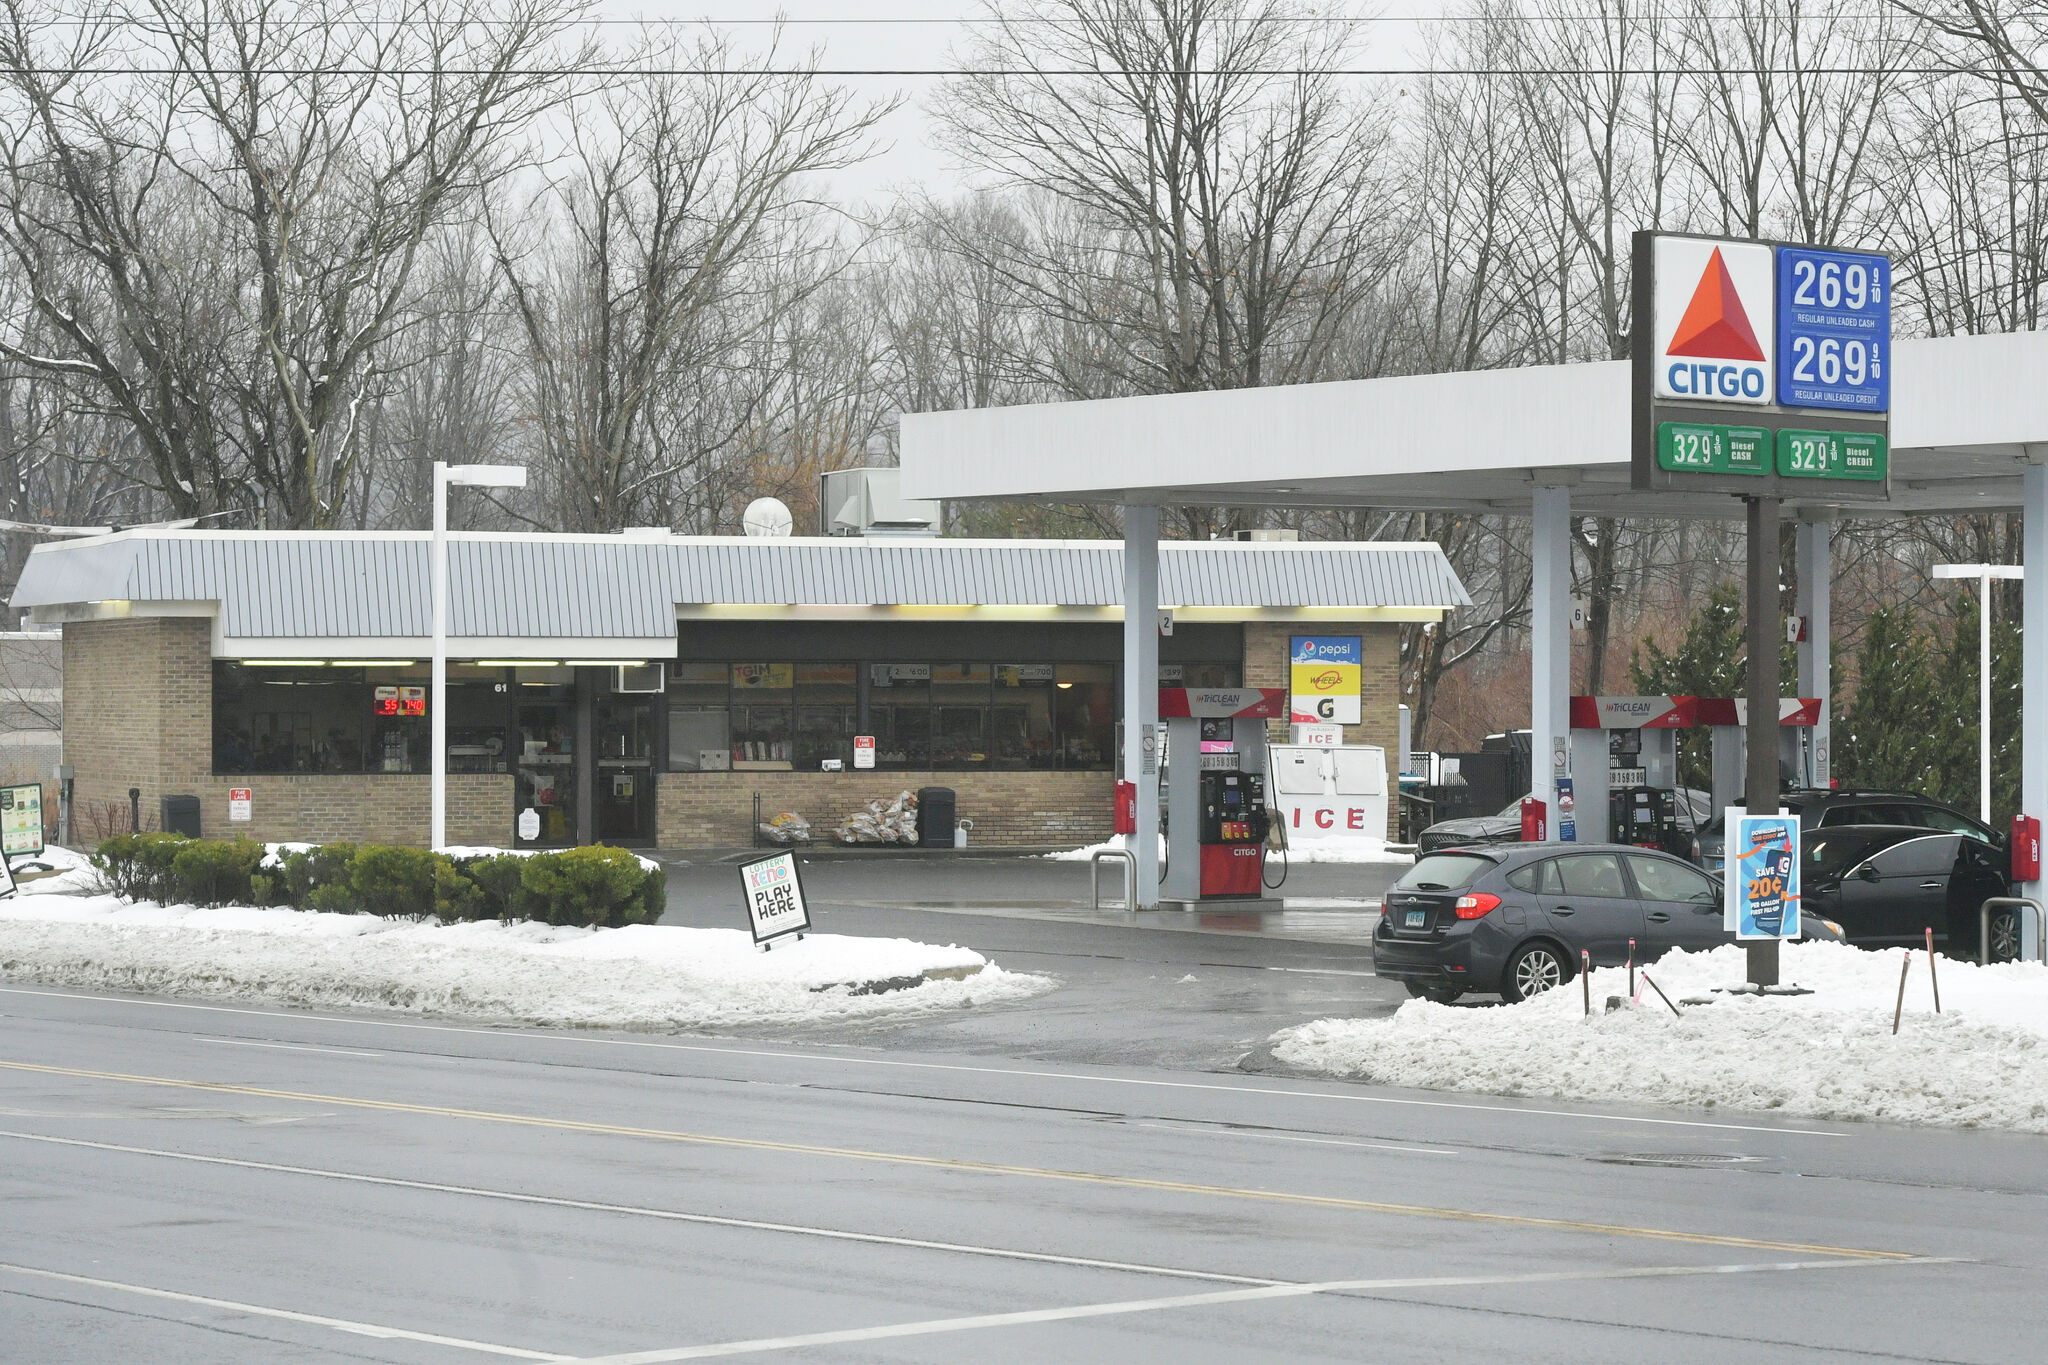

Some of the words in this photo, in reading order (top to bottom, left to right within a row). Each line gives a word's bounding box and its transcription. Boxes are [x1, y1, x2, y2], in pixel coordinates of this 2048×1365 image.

[1794, 260, 1867, 310] 269
[1797, 313, 1825, 324] REGULAR
[1826, 315, 1857, 327] UNLEADED
[1858, 319, 1875, 328] CASH
[1793, 336, 1866, 386] 269
[1668, 362, 1764, 398] CITGO
[1795, 390, 1823, 400] REGULAR
[1823, 392, 1855, 403] UNLEADED
[1855, 394, 1877, 404] CREDIT
[1674, 434, 1711, 463] 329
[1731, 441, 1754, 451] Diesel
[1846, 447, 1869, 457] Diesel
[1731, 451, 1751, 461] CASH
[1791, 440, 1826, 469] 329
[1846, 457, 1873, 467] CREDIT
[1575, 608, 1581, 621] 6
[1164, 616, 1170, 628] 2
[1791, 623, 1796, 634] 4
[1318, 643, 1350, 656] pepsi
[1310, 676, 1343, 685] WHEELS
[494, 683, 507, 692] 61
[384, 699, 398, 710] 55
[1317, 698, 1334, 718] G
[1308, 734, 1333, 744] ICE
[1293, 807, 1365, 829] ICE
[1233, 848, 1257, 856] CITGO
[749, 857, 785, 873] LOTTERY
[1756, 866, 1775, 877] SAVE
[750, 865, 787, 888] KENO
[1748, 876, 1782, 899] 20¢
[755, 883, 791, 906] PLAY
[758, 896, 796, 920] HERE
[1750, 901, 1760, 909] PER
[1760, 899, 1780, 907] GALLON
